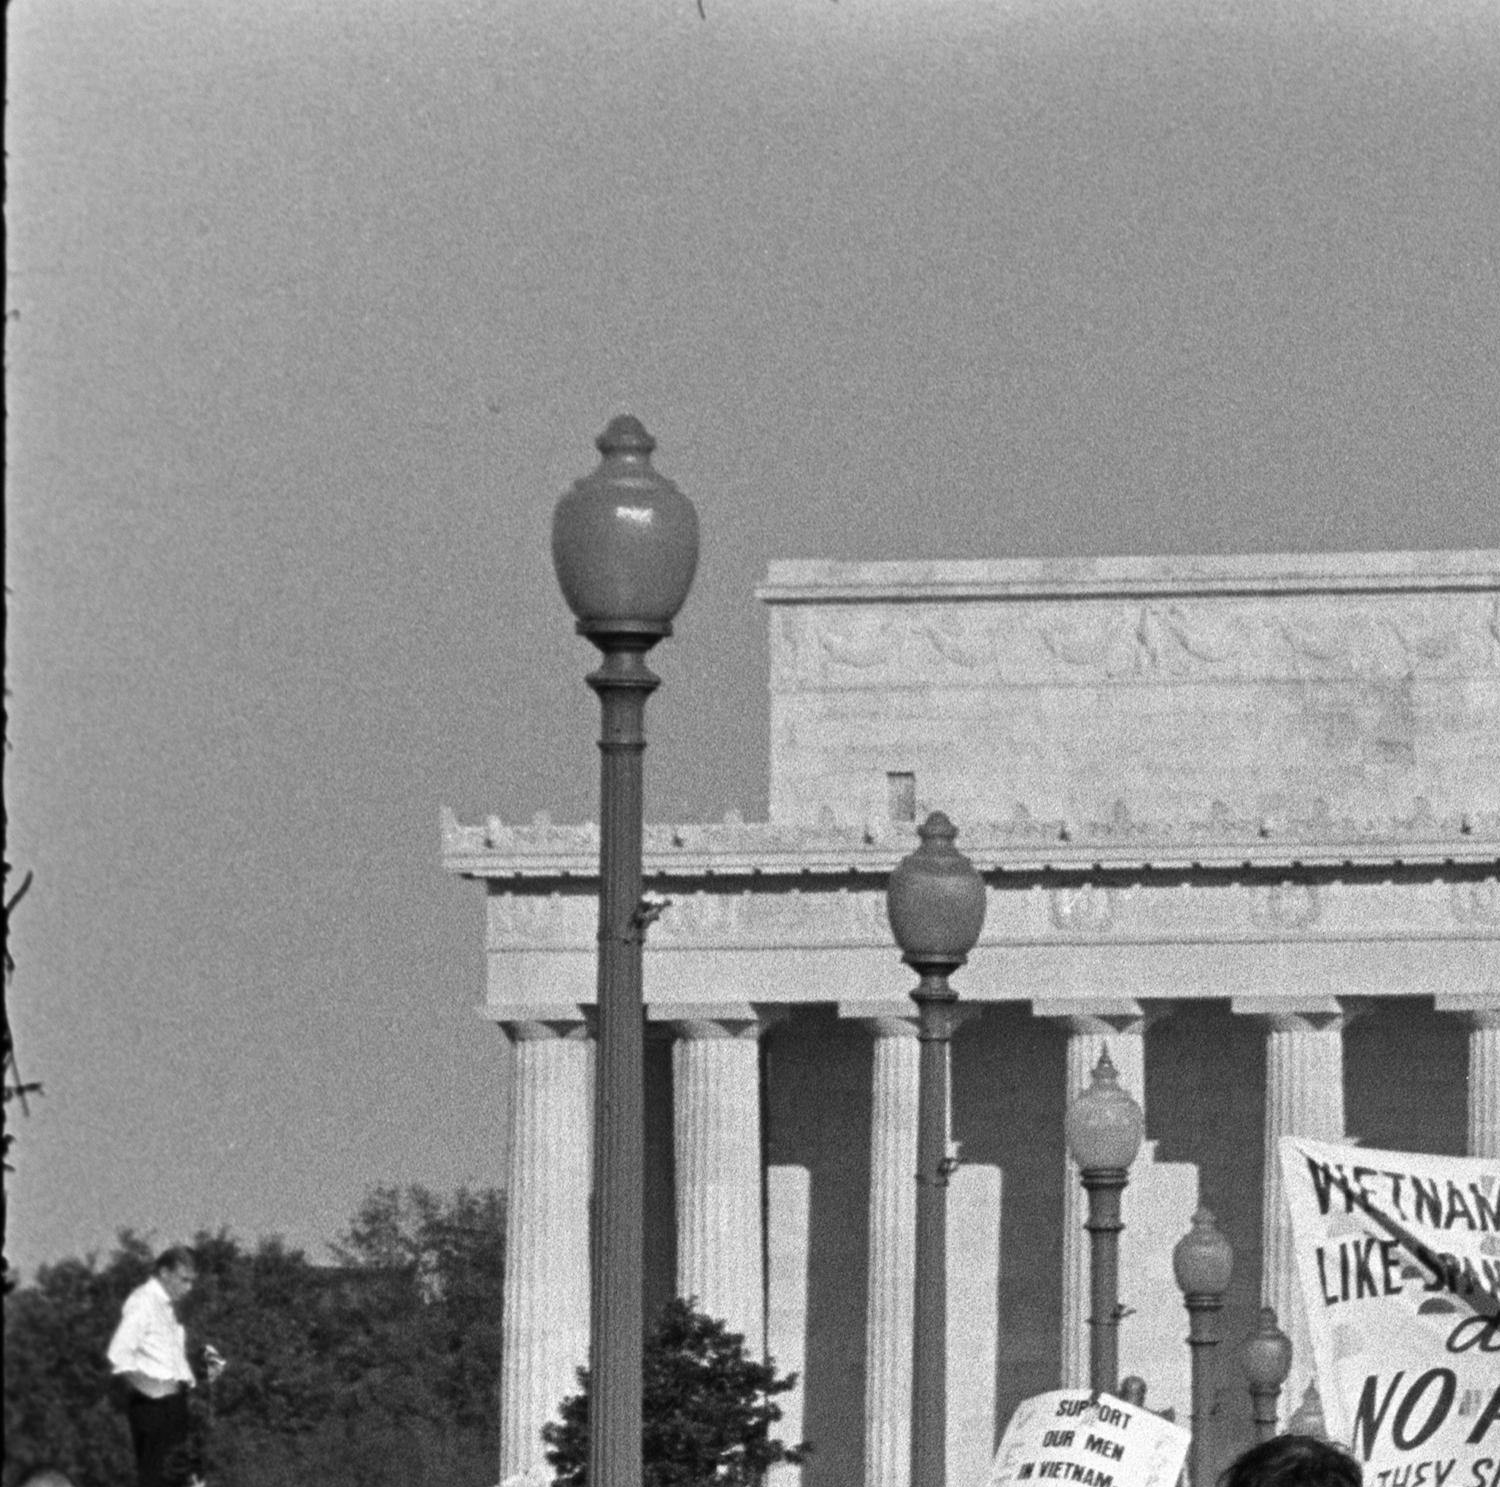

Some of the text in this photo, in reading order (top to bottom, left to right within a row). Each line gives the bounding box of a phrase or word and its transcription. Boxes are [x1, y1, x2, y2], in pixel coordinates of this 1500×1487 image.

[1316, 1236, 1403, 1307] LIKE
[1352, 1367, 1457, 1462] NO
[1017, 1462, 1034, 1481] IN
[1042, 1429, 1126, 1463] OUR MEN
